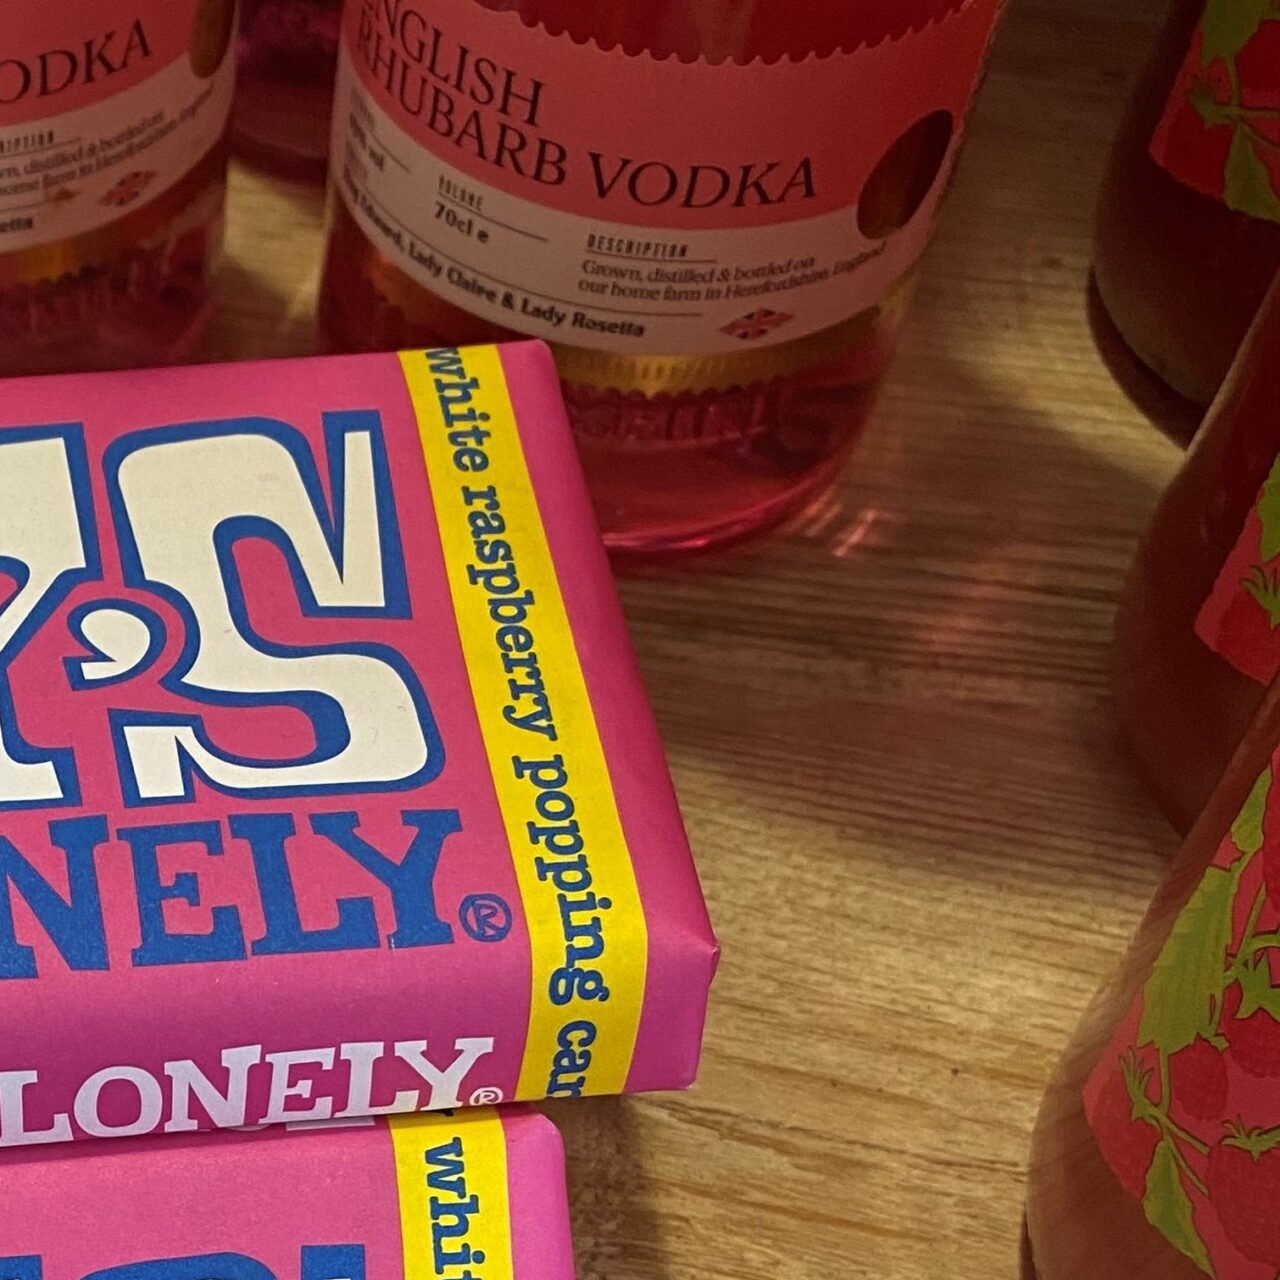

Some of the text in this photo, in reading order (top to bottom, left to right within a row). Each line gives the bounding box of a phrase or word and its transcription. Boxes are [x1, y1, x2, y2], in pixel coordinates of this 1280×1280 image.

[359, 6, 817, 208] RHUBARB VODKA
[434, 201, 473, 236] 70cl
[586, 232, 689, 258] DESCRIPTION
[408, 240, 443, 278] Lady
[447, 267, 497, 302] Claire
[501, 291, 515, 311] &
[521, 297, 567, 328] Lady
[572, 310, 646, 337] Rosetta
[581, 259, 643, 282] Grown,
[647, 267, 716, 284] distilled
[733, 258, 792, 282] bottled
[577, 278, 608, 295] our
[610, 281, 661, 300] home
[424, 346, 492, 473] white
[461, 484, 559, 742] raspberry
[511, 753, 613, 1007] popping
